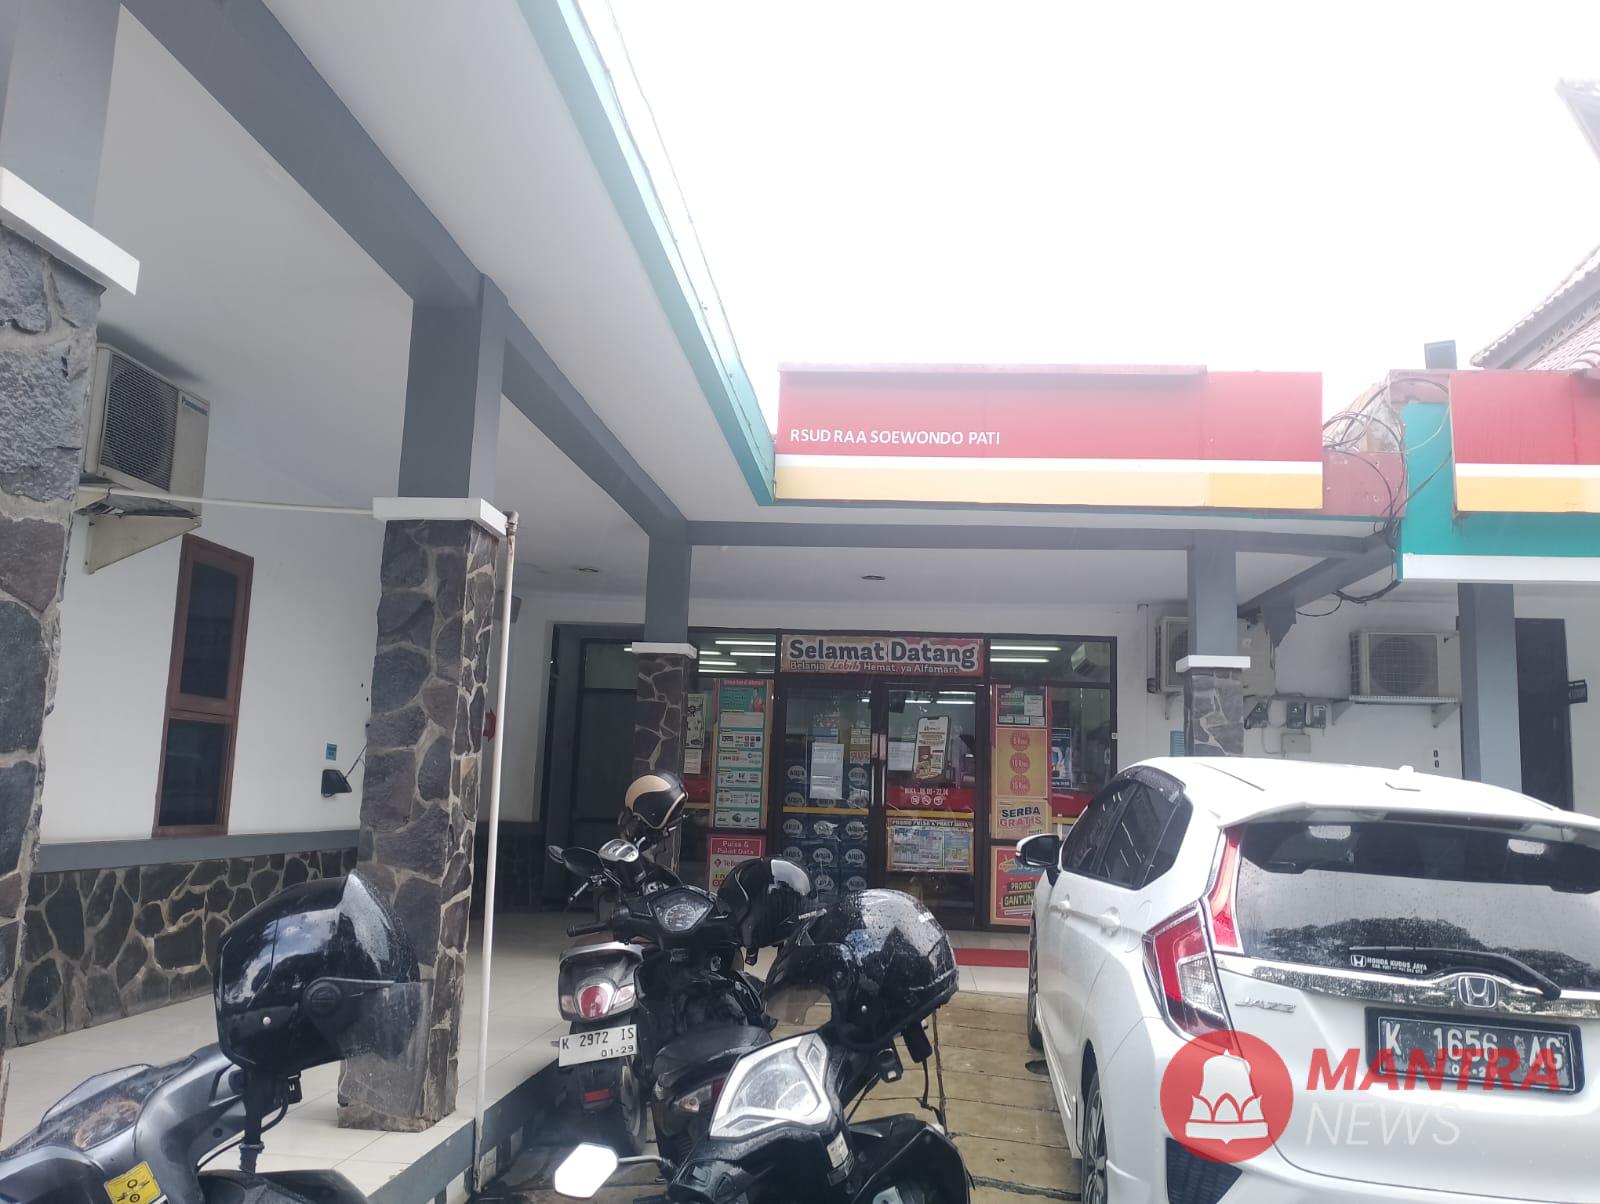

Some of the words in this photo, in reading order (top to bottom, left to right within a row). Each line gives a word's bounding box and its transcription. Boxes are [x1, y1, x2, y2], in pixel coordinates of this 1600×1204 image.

[790, 428, 831, 443] RSUD
[834, 430, 867, 444] RAA
[870, 430, 964, 445] SOEWONDO
[968, 431, 1000, 445] PATI
[789, 639, 886, 661] Selamat
[890, 641, 976, 669] Datang
[790, 661, 825, 671] Belanja
[1001, 806, 1041, 818] SERBA
[1000, 815, 1042, 828] GRATIS
[1010, 881, 1032, 891] PROMO
[1004, 893, 1035, 906] GANTUN
[1367, 957, 1389, 966] HONDA
[1390, 960, 1411, 968] KUDUS
[1412, 963, 1427, 971] JAYA
[562, 1038, 569, 1050] K
[579, 1031, 609, 1047] 2972
[621, 1027, 634, 1041] IS
[1385, 1022, 1401, 1056] K
[1433, 1026, 1499, 1063] 1656
[1529, 1035, 1564, 1070] AG
